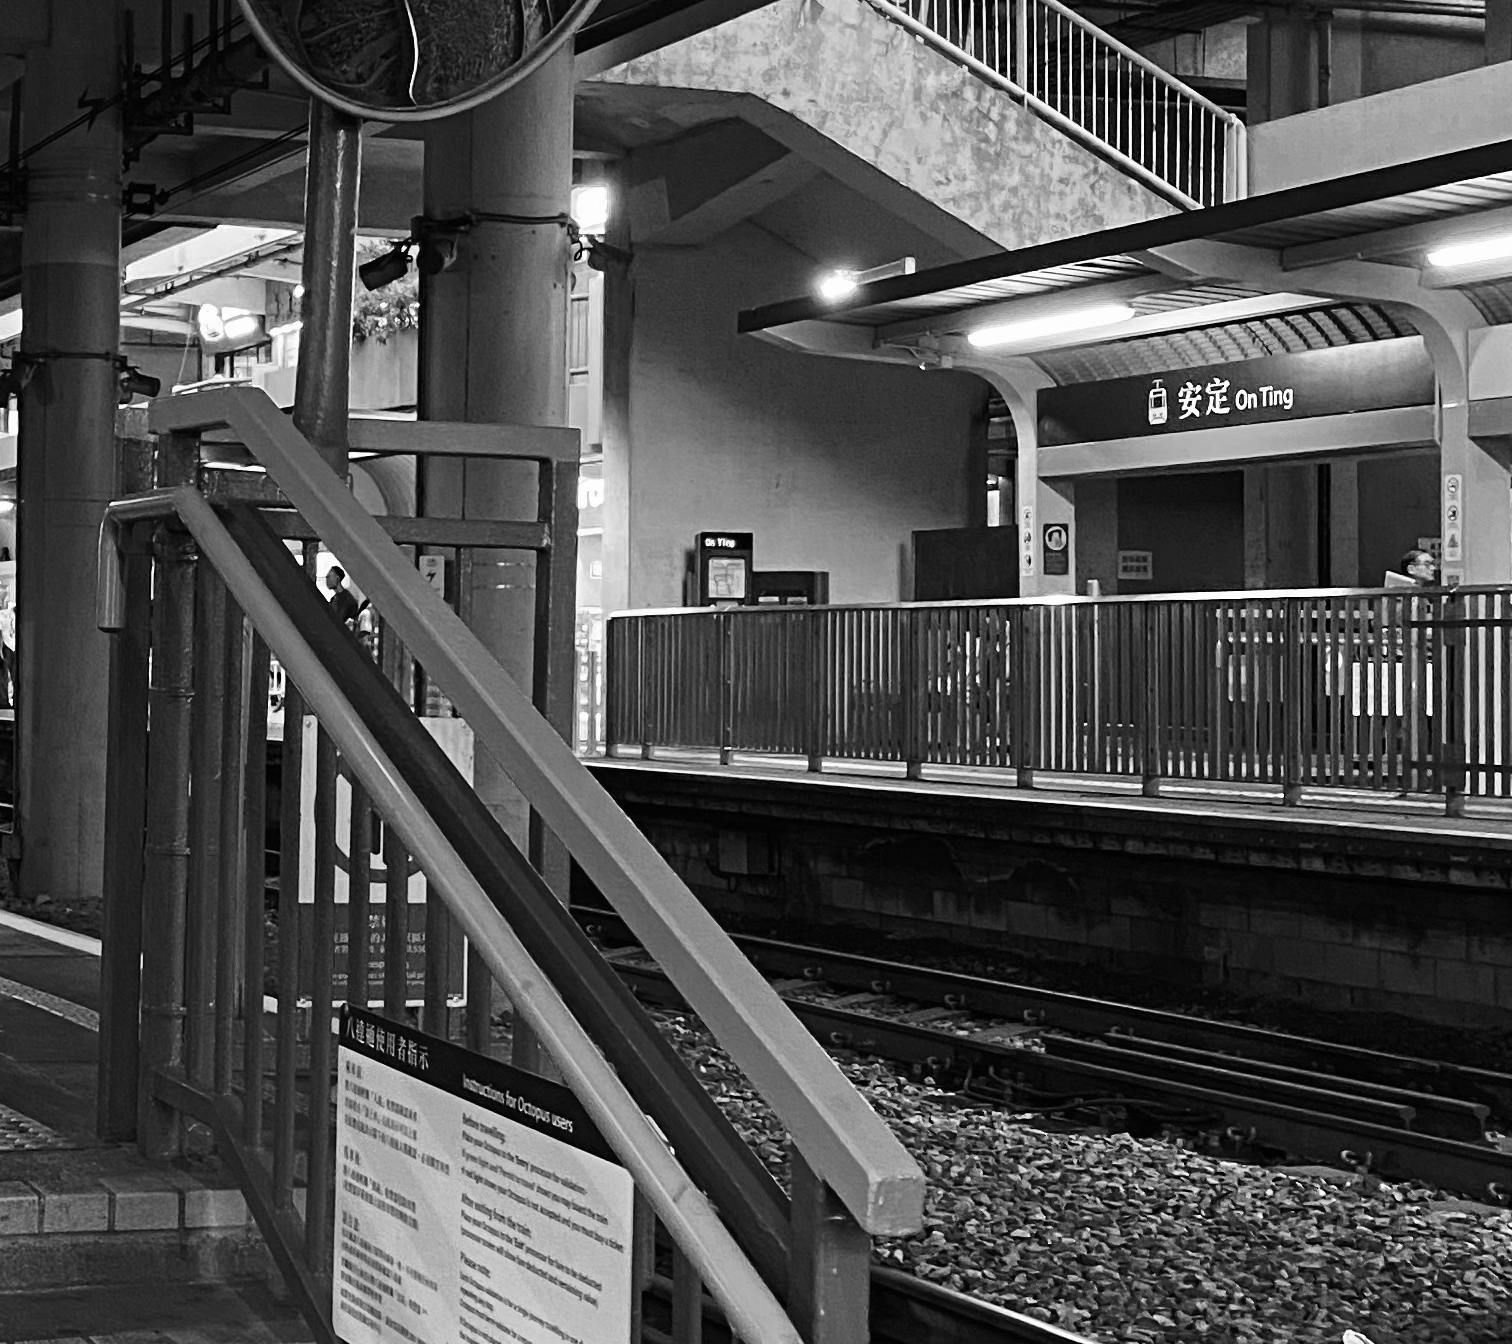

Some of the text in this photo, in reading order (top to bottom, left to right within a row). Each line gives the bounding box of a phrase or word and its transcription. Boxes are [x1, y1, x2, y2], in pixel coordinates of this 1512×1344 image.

[1177, 377, 1231, 420] 安定
[1235, 385, 1294, 411] On Ting
[462, 1071, 573, 1133] Instructions for Octopus users
